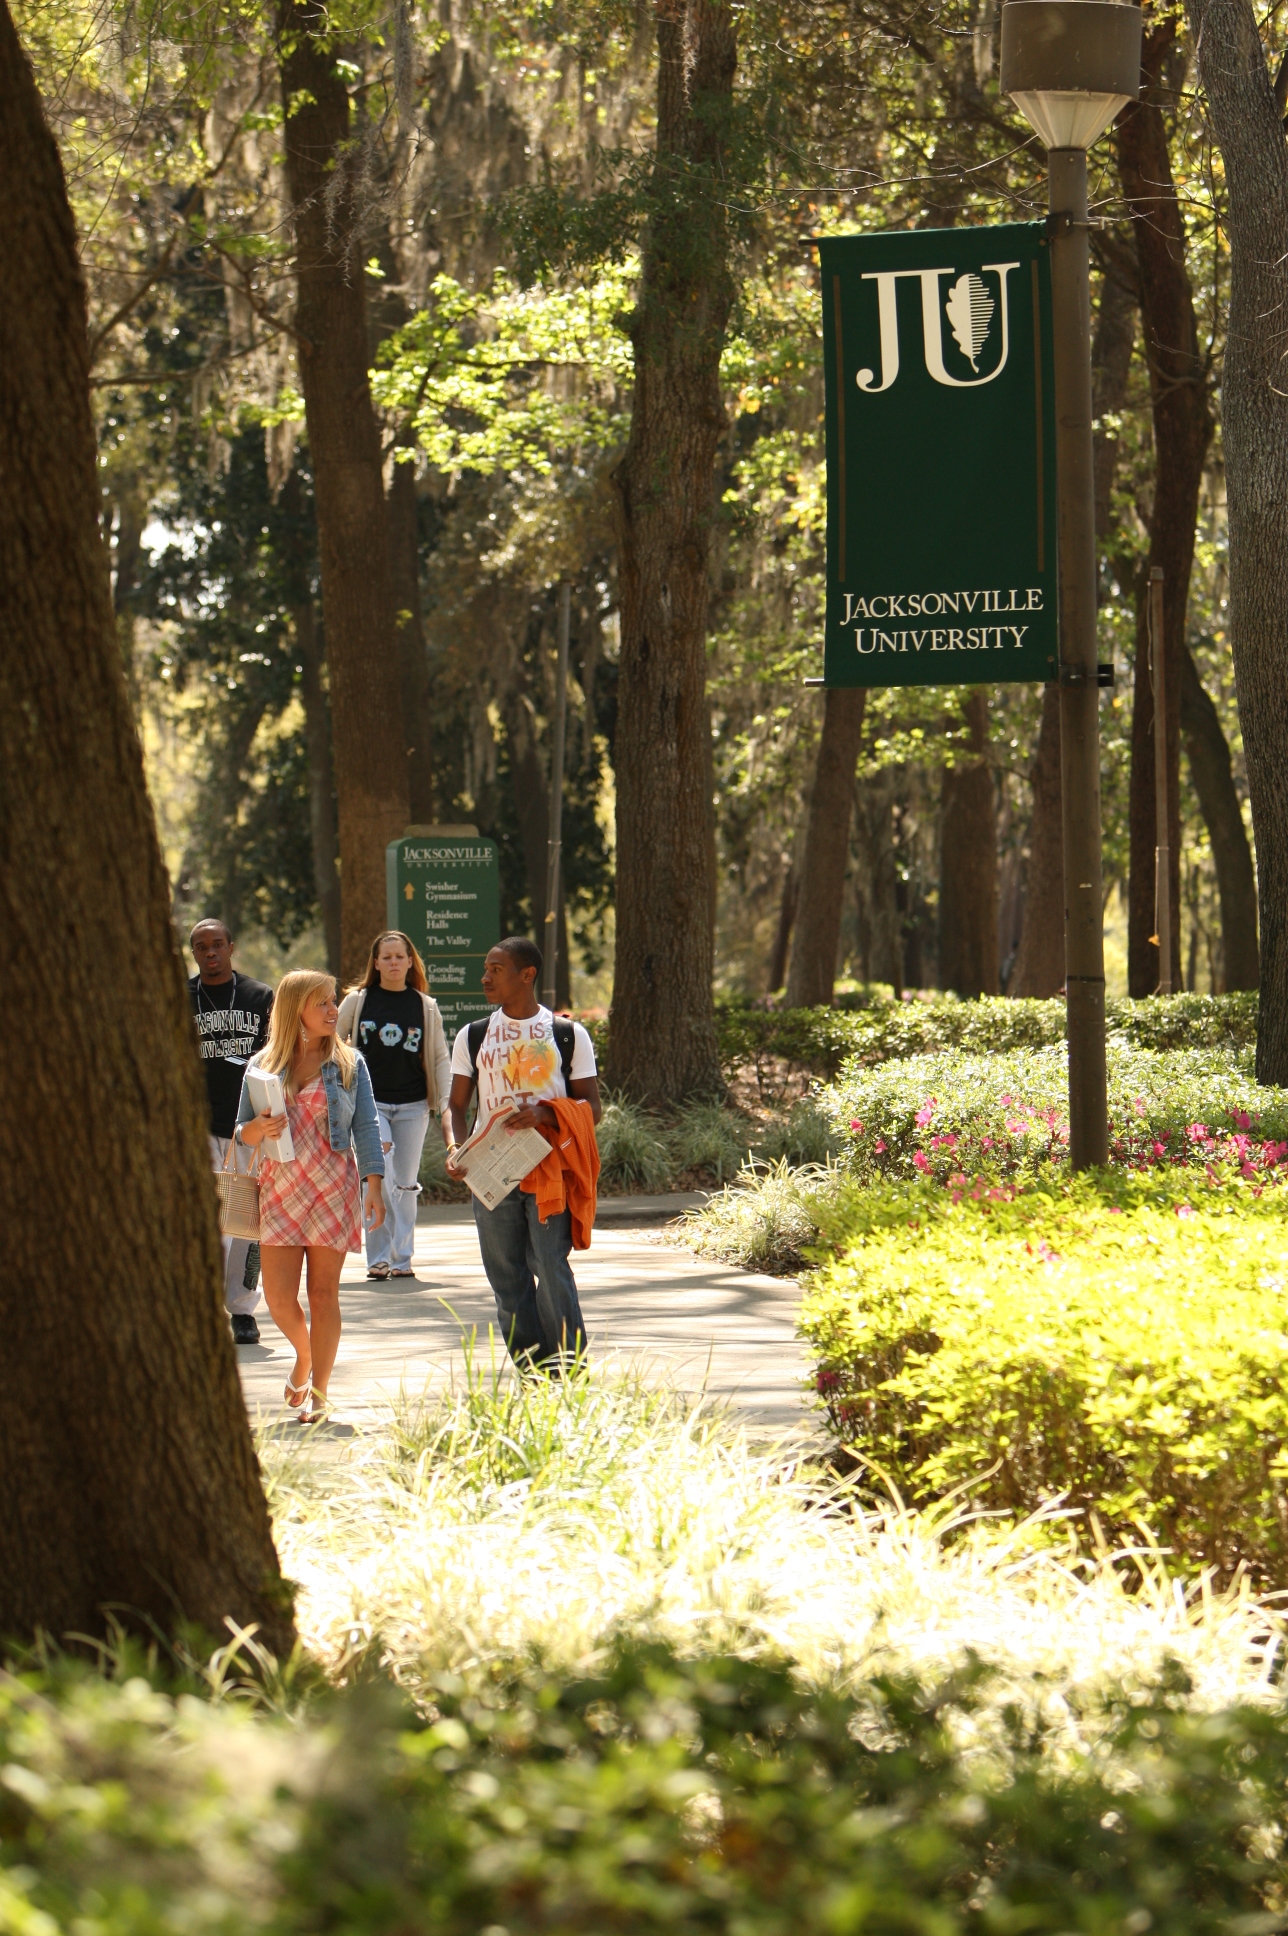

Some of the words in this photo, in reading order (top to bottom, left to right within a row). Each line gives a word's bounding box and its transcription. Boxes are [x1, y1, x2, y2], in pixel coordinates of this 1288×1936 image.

[856, 262, 1021, 393] JU
[840, 588, 1045, 627] JACKSONVILLE
[854, 626, 1029, 655] UNIVERSITY
[403, 846, 493, 861] JACKSONVILLE
[425, 881, 459, 892] Swisher
[425, 891, 478, 904] Gymnasium
[426, 910, 469, 920] Residence
[426, 919, 450, 930] Halls
[426, 936, 445, 946] The
[446, 935, 472, 948] Valley
[427, 963, 466, 976] Gooding
[428, 973, 466, 986] Building
[455, 1001, 499, 1013] University
[483, 1021, 522, 1047] HIS
[480, 1044, 525, 1070] WHY
